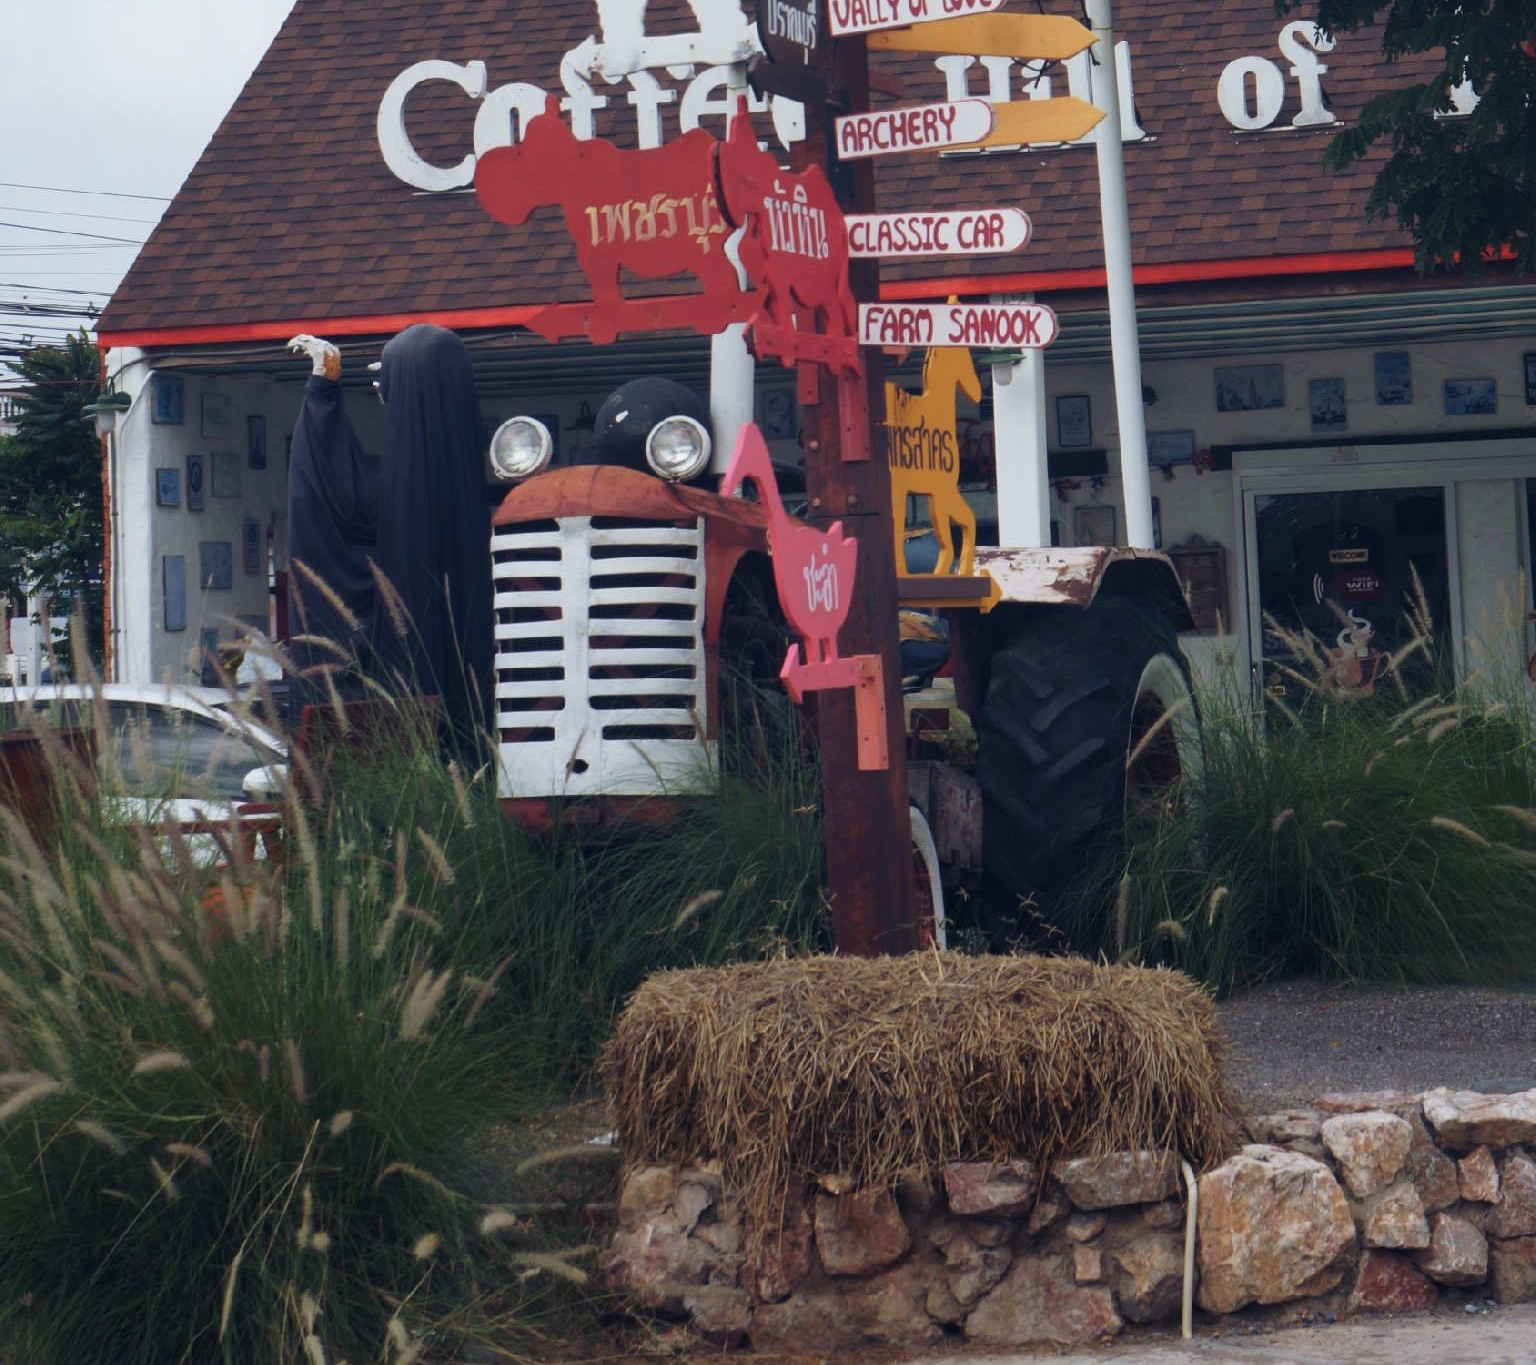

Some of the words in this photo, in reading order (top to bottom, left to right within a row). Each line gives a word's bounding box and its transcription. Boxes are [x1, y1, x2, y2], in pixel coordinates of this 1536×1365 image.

[1216, 21, 1337, 131] of
[841, 106, 956, 153] ARCHERY
[763, 178, 829, 260] หัวหิน
[850, 216, 950, 252] CLASSIC
[957, 213, 1004, 248] CAR
[865, 307, 933, 343] FARM
[948, 309, 1042, 344] SANOOK
